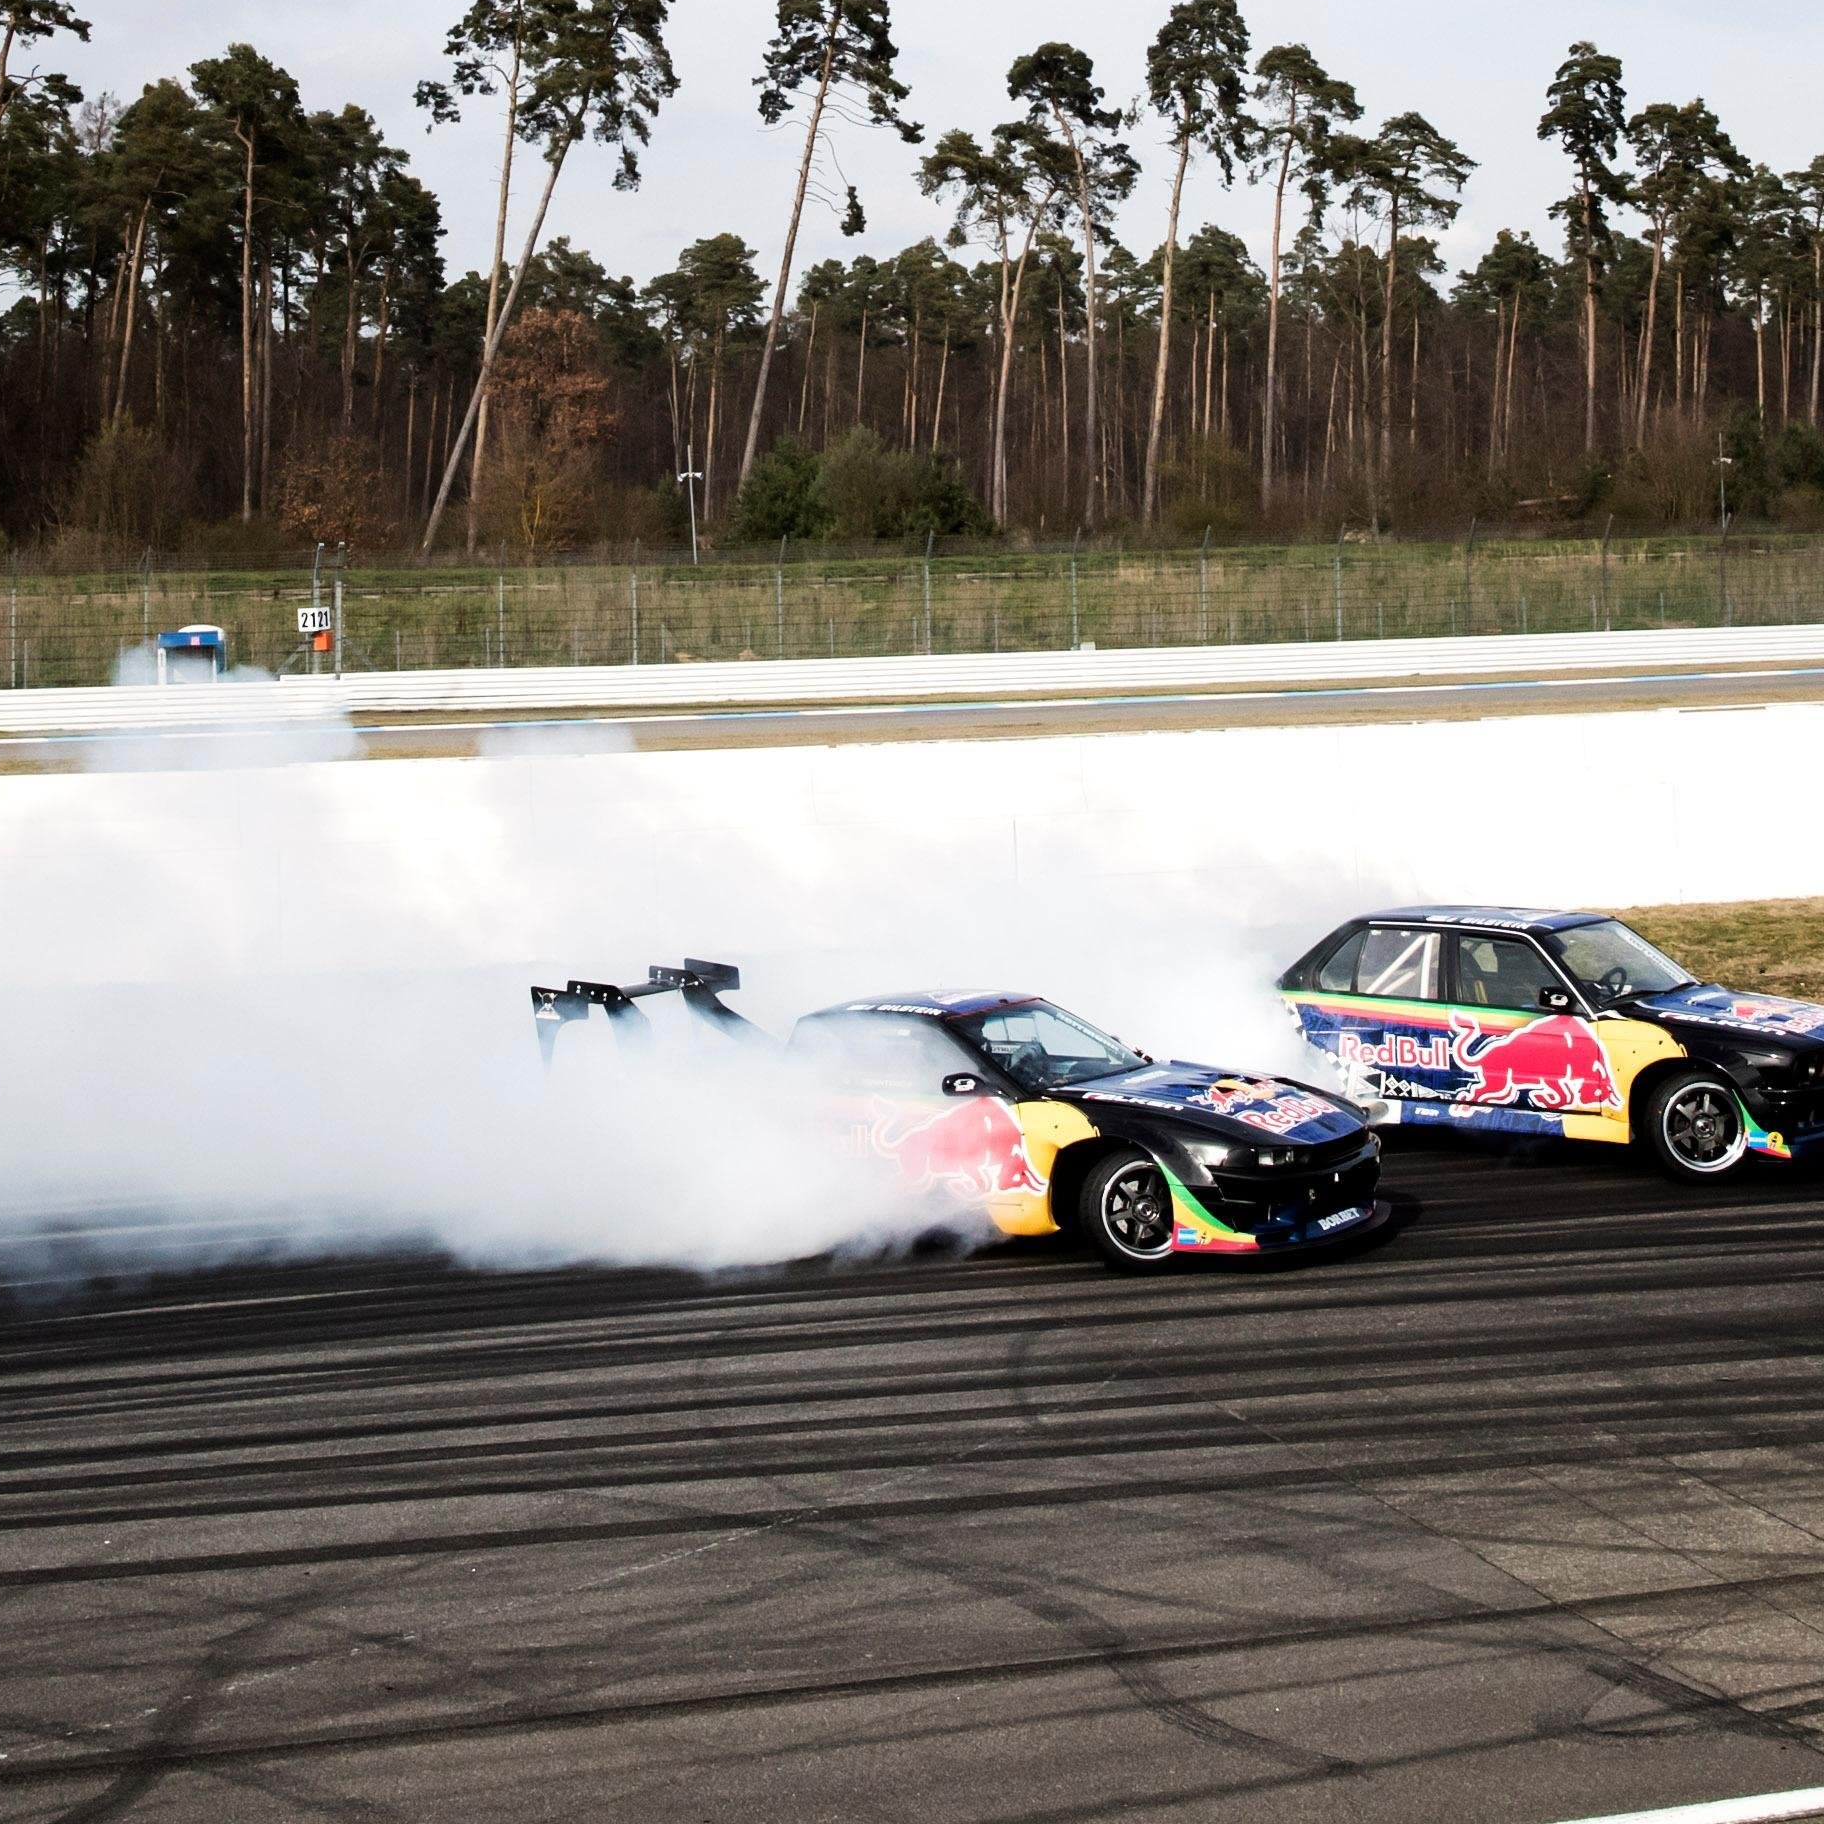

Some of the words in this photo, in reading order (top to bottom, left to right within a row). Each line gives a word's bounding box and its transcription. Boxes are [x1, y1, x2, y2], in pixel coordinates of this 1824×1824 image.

[1460, 917, 1530, 930] BILSTEIN
[877, 1004, 945, 1016] BILSTEIN
[1658, 1012, 1787, 1036] FALKEN
[1082, 1090, 1184, 1111] FALKEN
